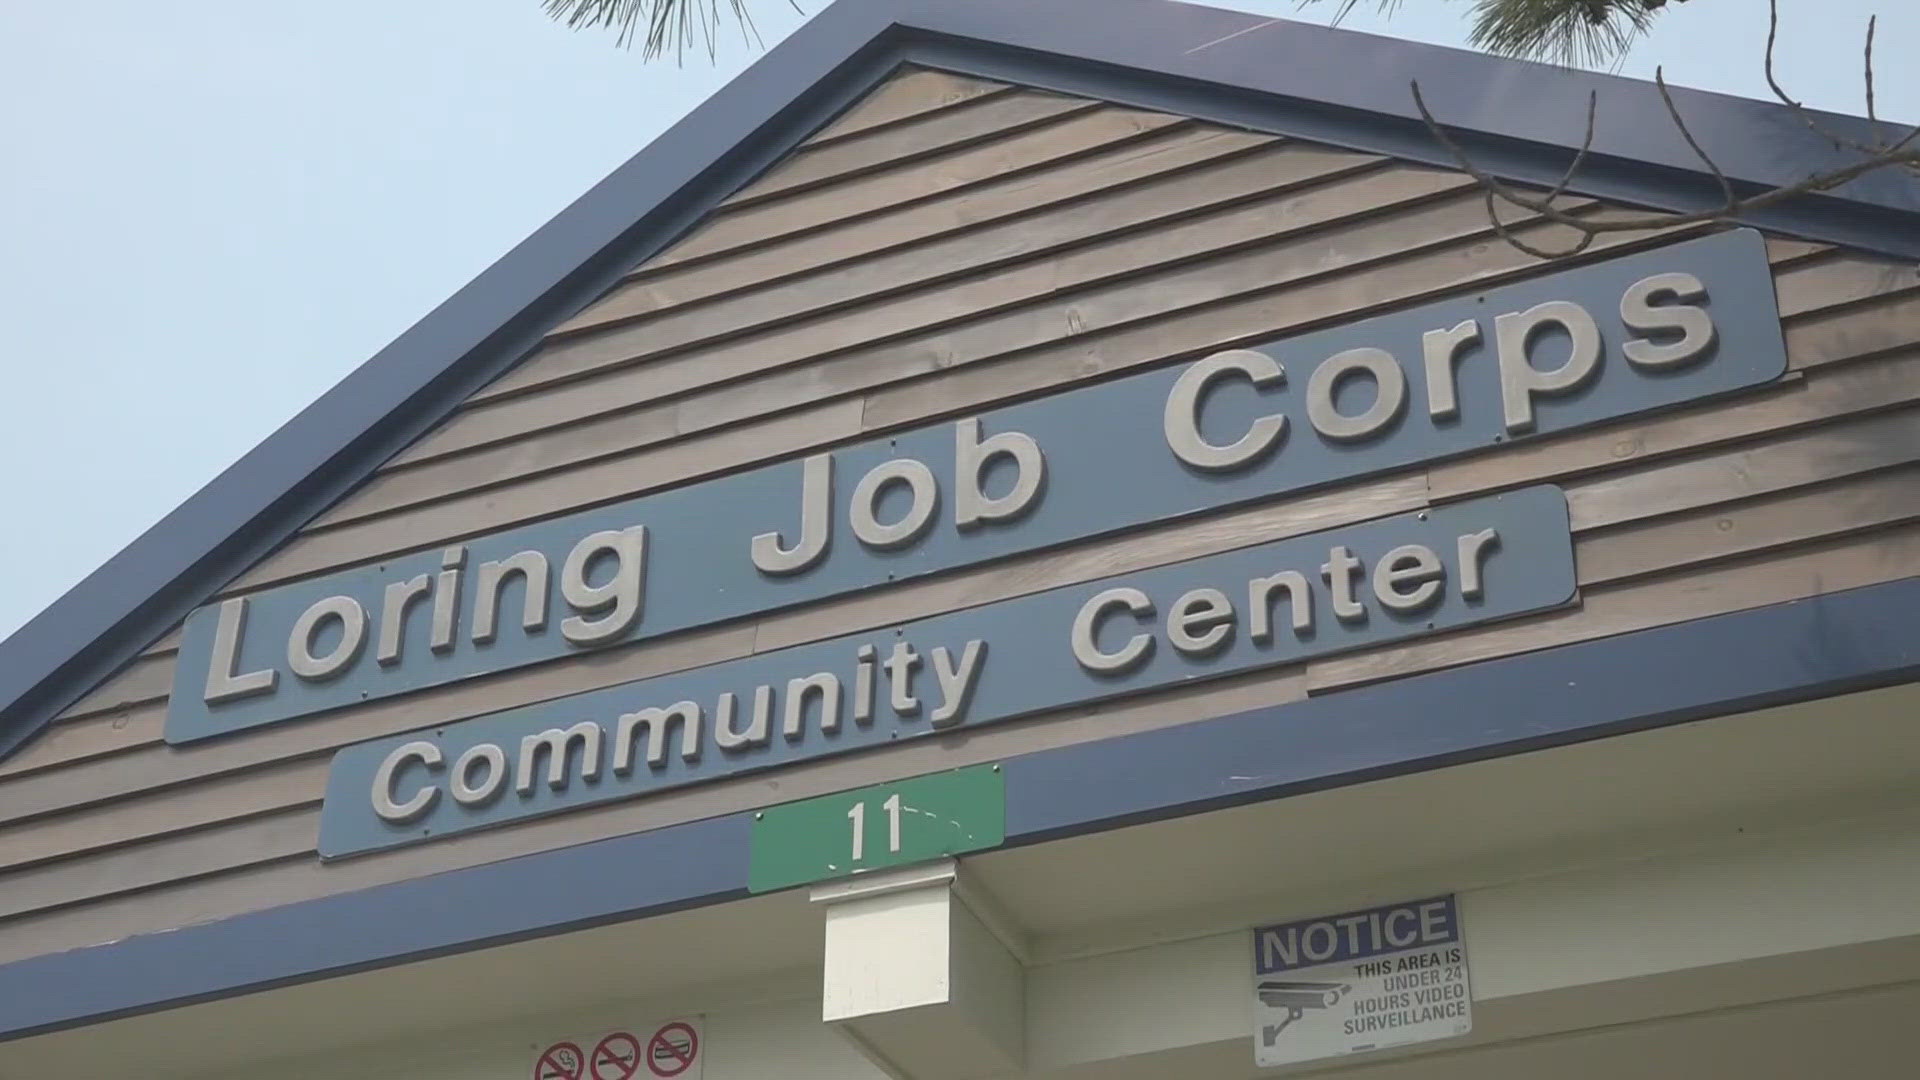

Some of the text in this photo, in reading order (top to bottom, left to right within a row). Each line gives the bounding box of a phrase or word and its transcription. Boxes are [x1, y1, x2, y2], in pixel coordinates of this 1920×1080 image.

[204, 272, 1717, 703] Loring Job Corps
[371, 527, 1500, 823] Community Center
[848, 794, 899, 860] 11
[1262, 902, 1449, 969] NOTICE
[1354, 948, 1461, 978] THIS AREA IS
[1384, 966, 1462, 992] UNDER 24
[1344, 1001, 1466, 1034] SURVEILLANCE
[1354, 983, 1464, 1016] HOURS VIDEO
